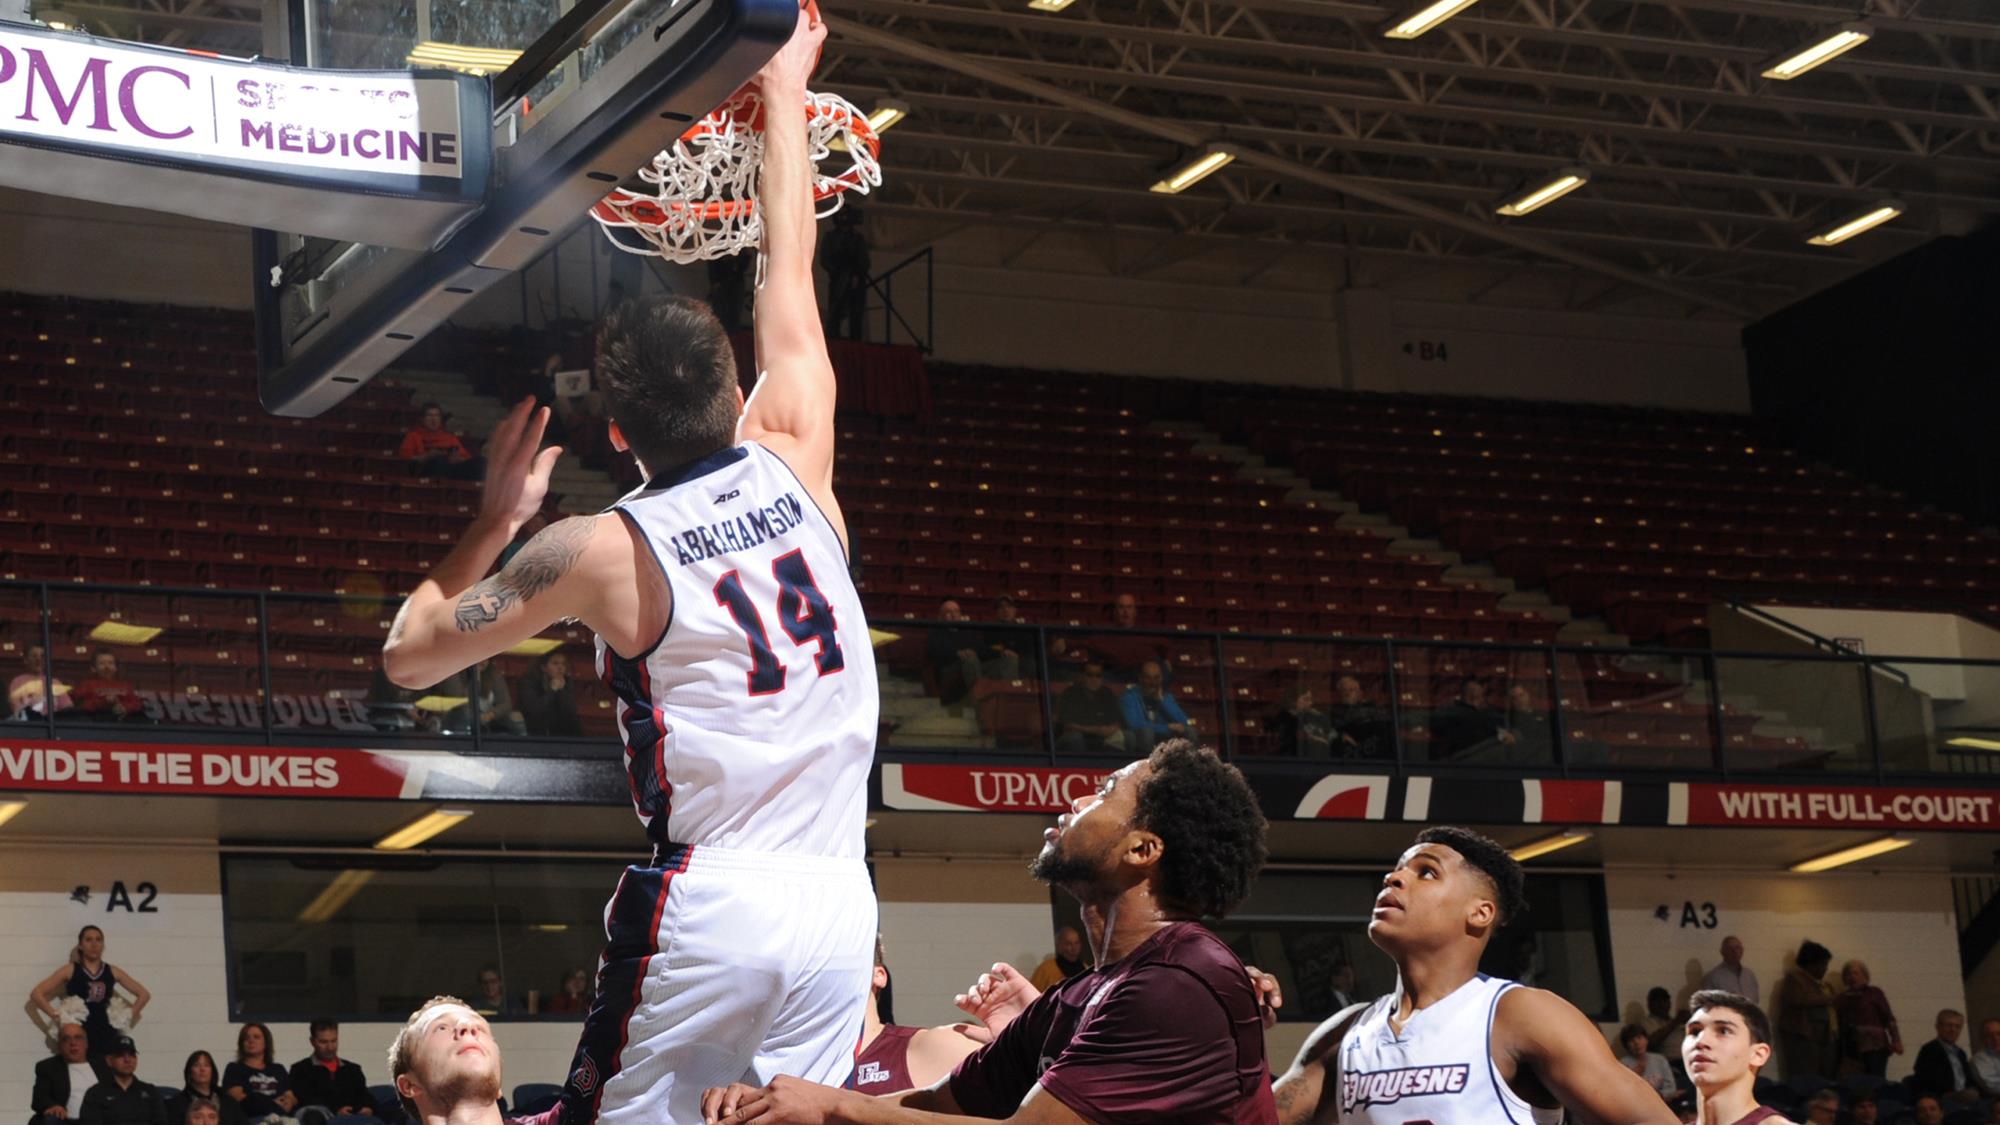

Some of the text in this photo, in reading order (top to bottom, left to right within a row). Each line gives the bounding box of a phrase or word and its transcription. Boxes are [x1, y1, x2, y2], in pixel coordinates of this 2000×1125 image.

[240, 118, 457, 164] MEDICINE
[1419, 341, 1448, 362] B4
[671, 492, 804, 566] ABRAHAMSON
[713, 547, 844, 697] 14
[0, 748, 340, 788] VIDE THE DUKES
[969, 771, 1088, 807] UPMC
[1718, 791, 1801, 819] WITH
[1808, 793, 1993, 823] FULL-COURT
[106, 880, 159, 913] A2
[1680, 901, 1718, 929] A3
